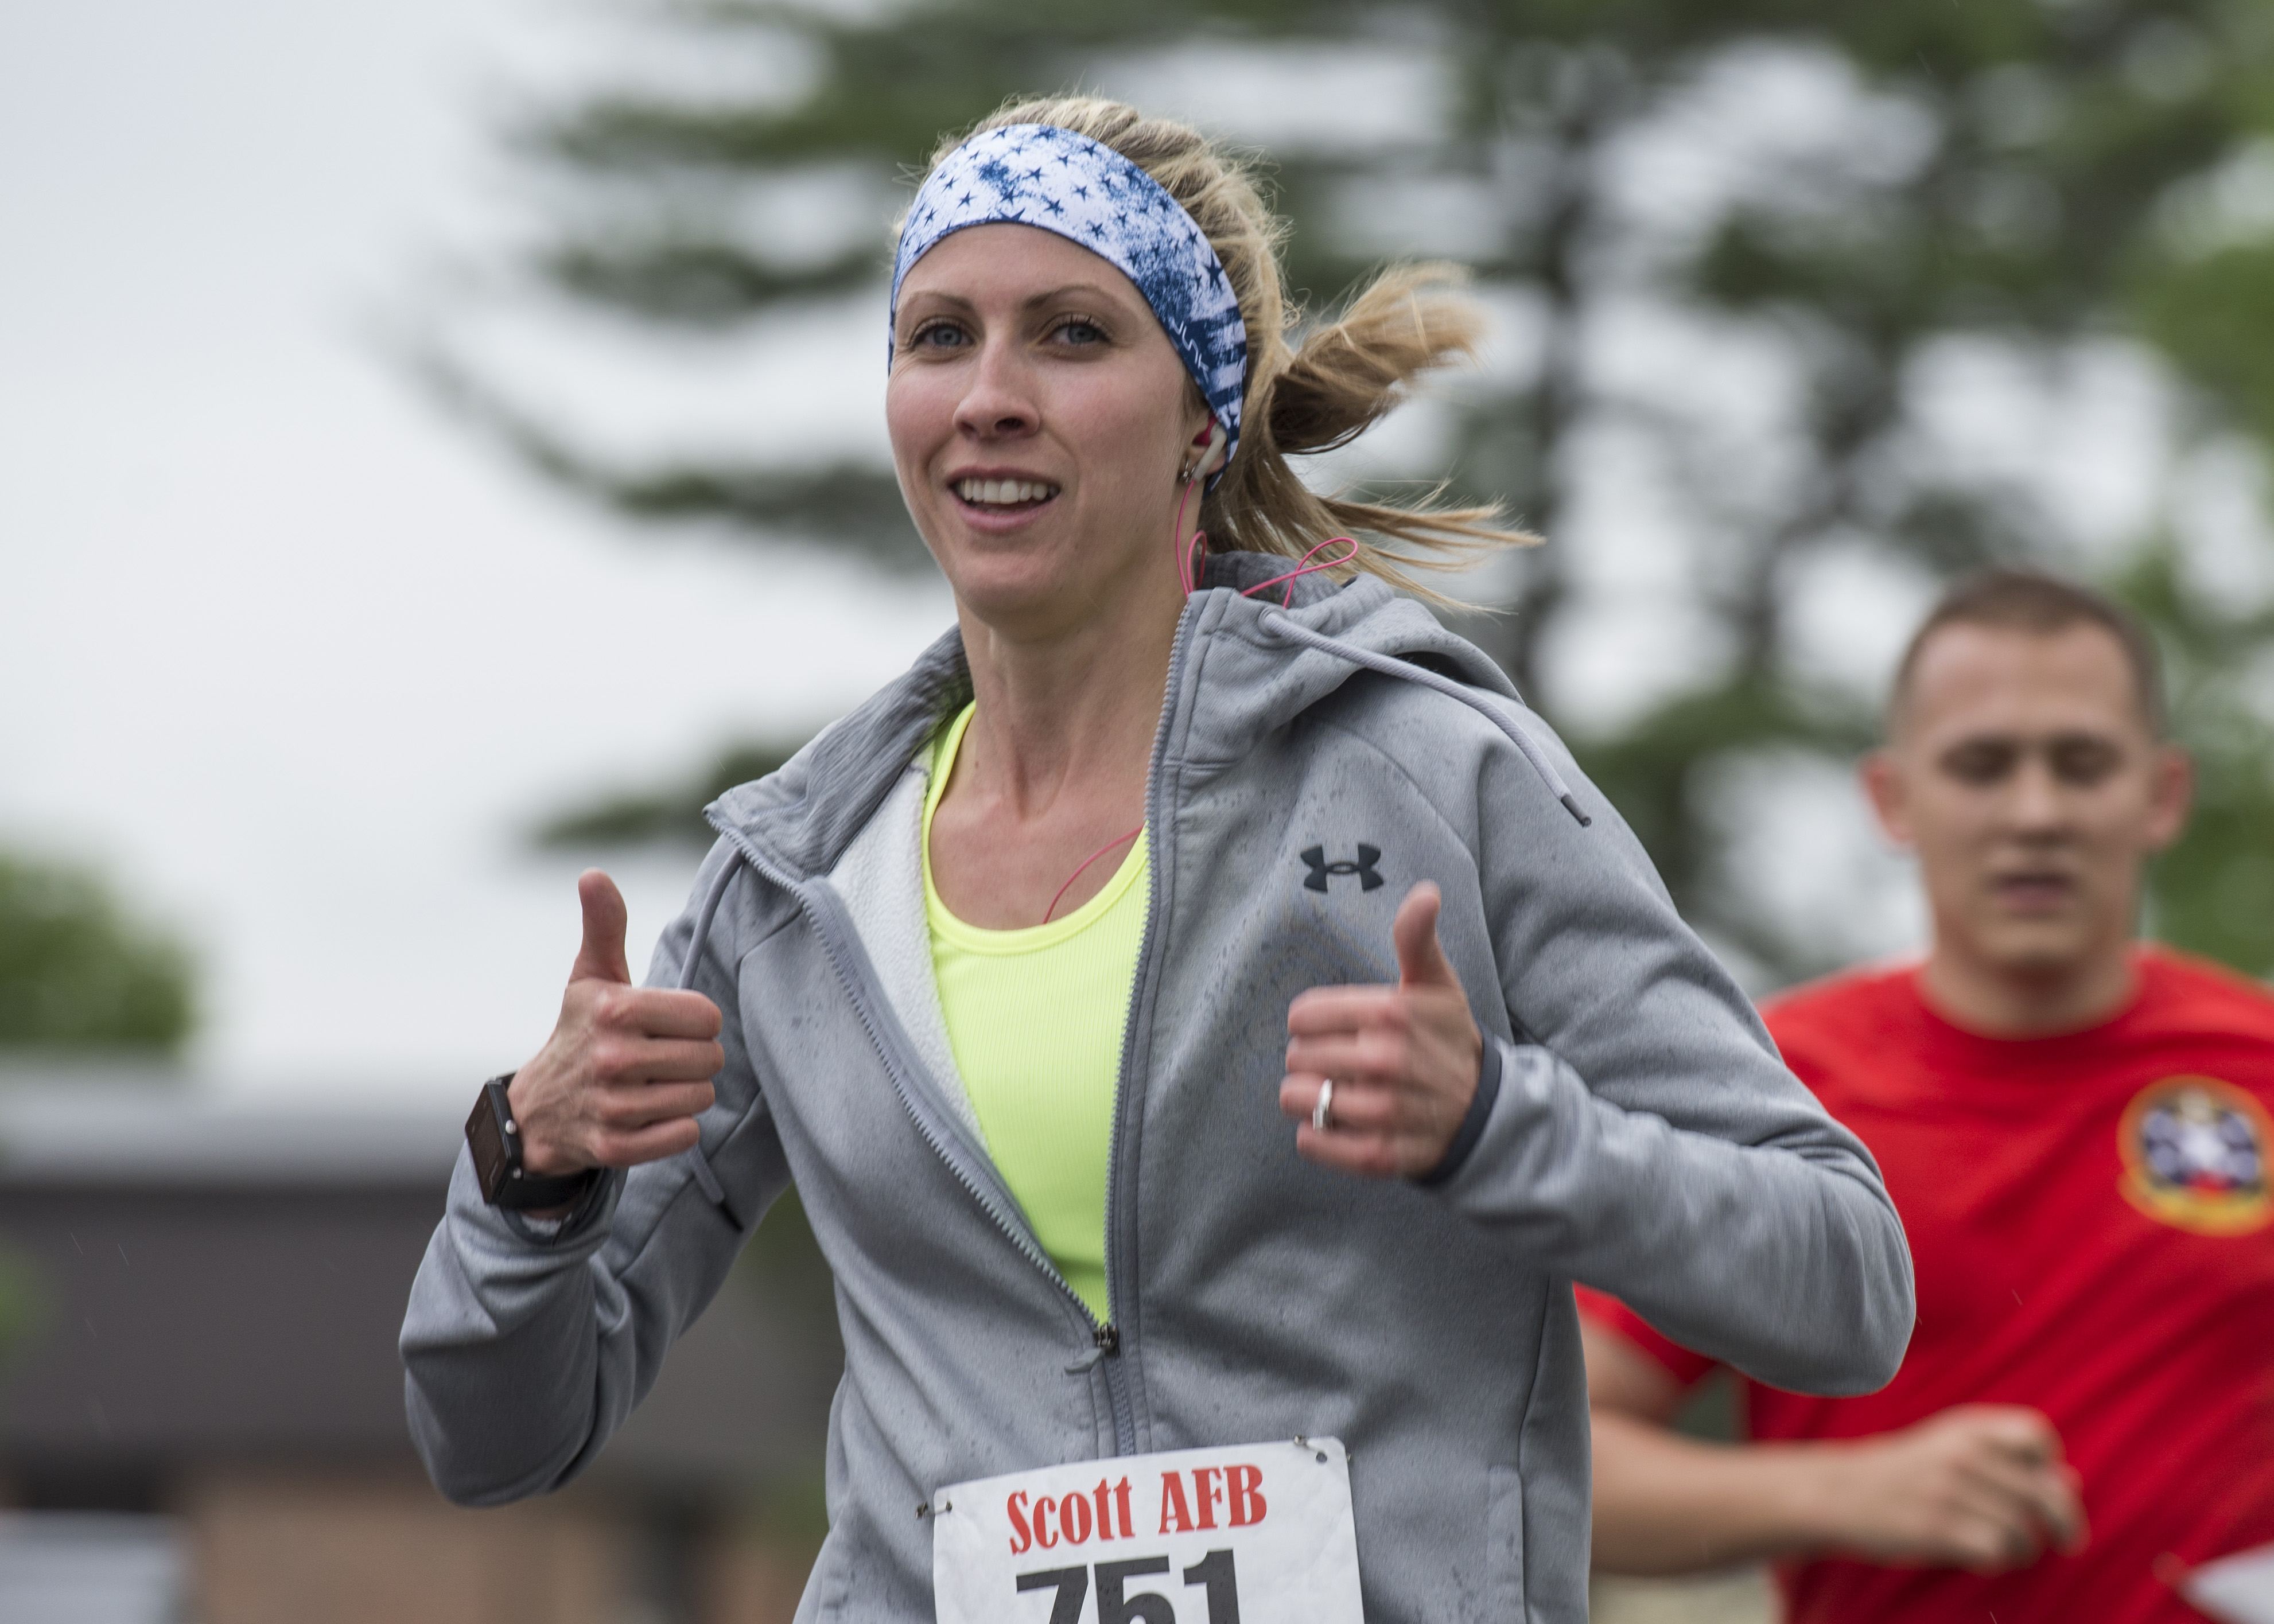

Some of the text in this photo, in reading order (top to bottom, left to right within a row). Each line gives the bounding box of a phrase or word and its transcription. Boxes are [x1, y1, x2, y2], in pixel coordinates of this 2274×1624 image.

[1169, 316, 1210, 384] JUNK
[1006, 1464, 1267, 1554] Scott AFB
[1016, 1547, 1240, 1624] 751
